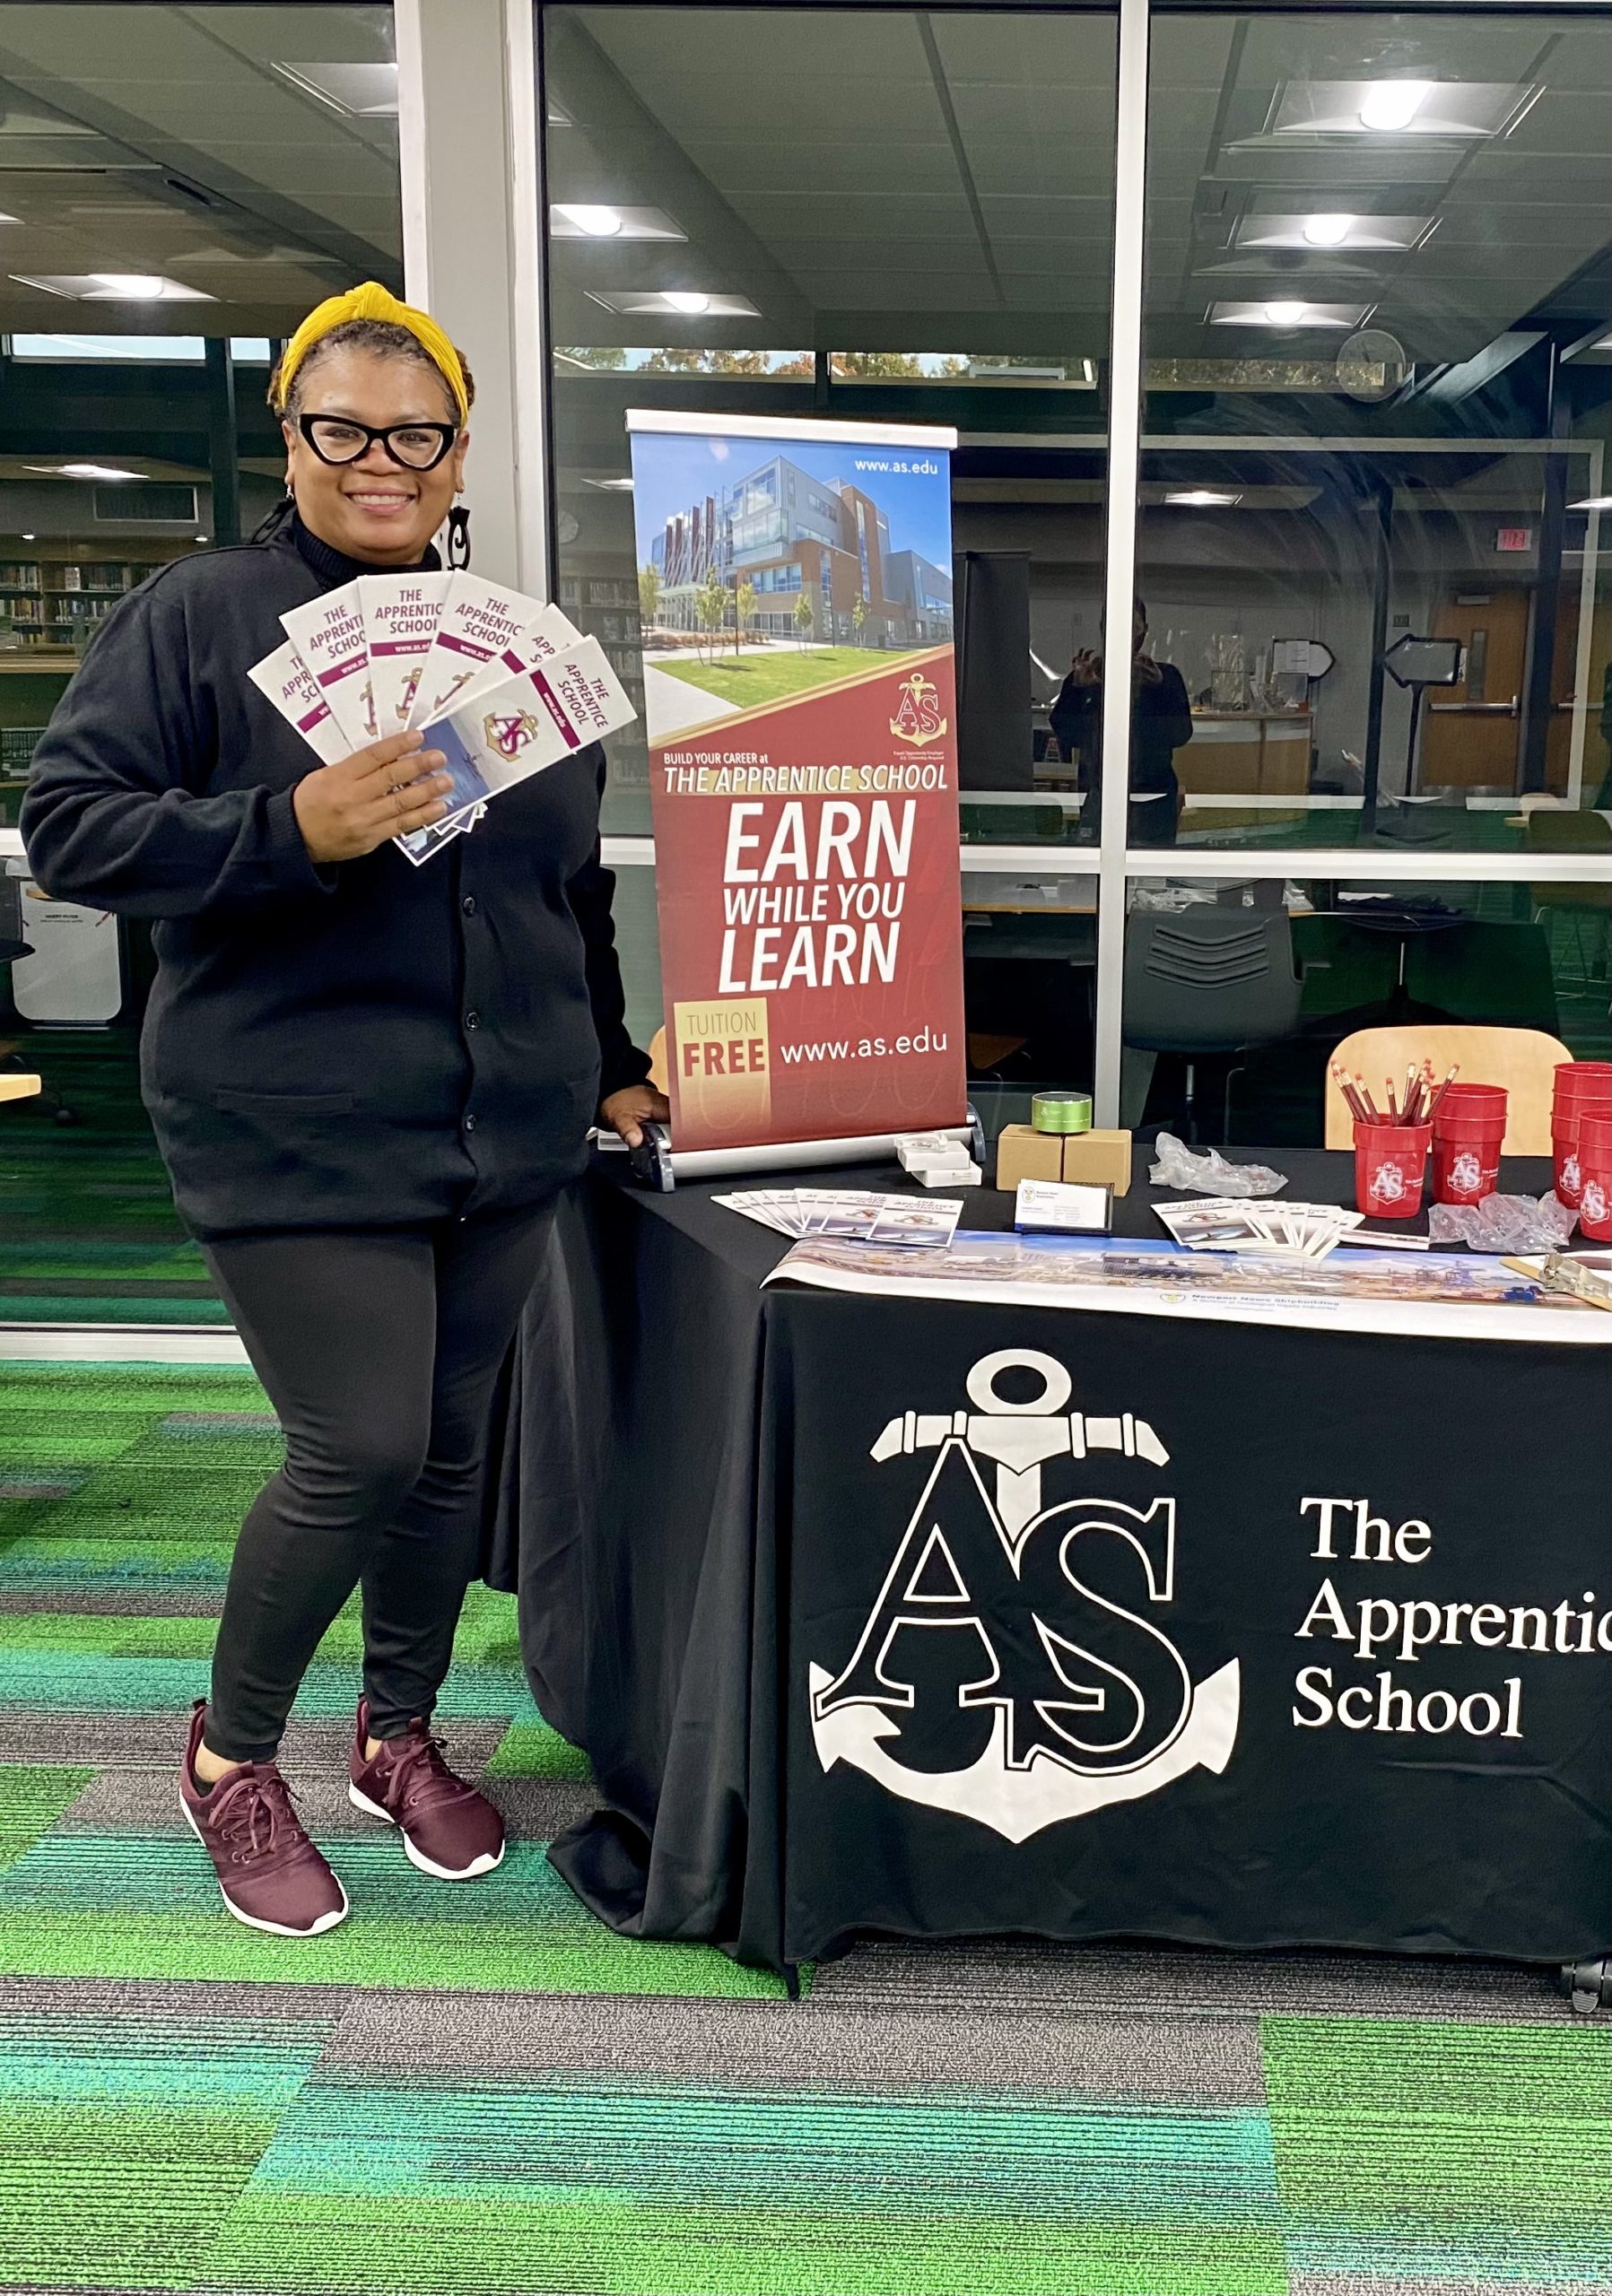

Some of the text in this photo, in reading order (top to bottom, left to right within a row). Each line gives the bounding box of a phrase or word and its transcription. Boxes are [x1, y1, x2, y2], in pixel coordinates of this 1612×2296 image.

[855, 459, 937, 474] www.as.edu
[399, 588, 423, 602] THE
[485, 597, 510, 615] THE
[324, 604, 348, 624] THE
[455, 603, 526, 636] APPRENTIC
[557, 681, 589, 726] SCHOOL
[564, 664, 609, 728] APPRENTICE
[590, 678, 610, 700] THE
[664, 752, 769, 764] BUILD YOUR CAREER at
[664, 764, 948, 793] THE APPRENTICE SCHOOL
[723, 799, 917, 883] EARN
[723, 882, 905, 926] WHILE YOU
[719, 921, 901, 994] LEARN
[687, 1011, 756, 1036] TUITION
[683, 1039, 765, 1077] FREE
[780, 1025, 947, 1064] www.as.edu
[1300, 1497, 1432, 1563] The
[1293, 1666, 1523, 1738] School
